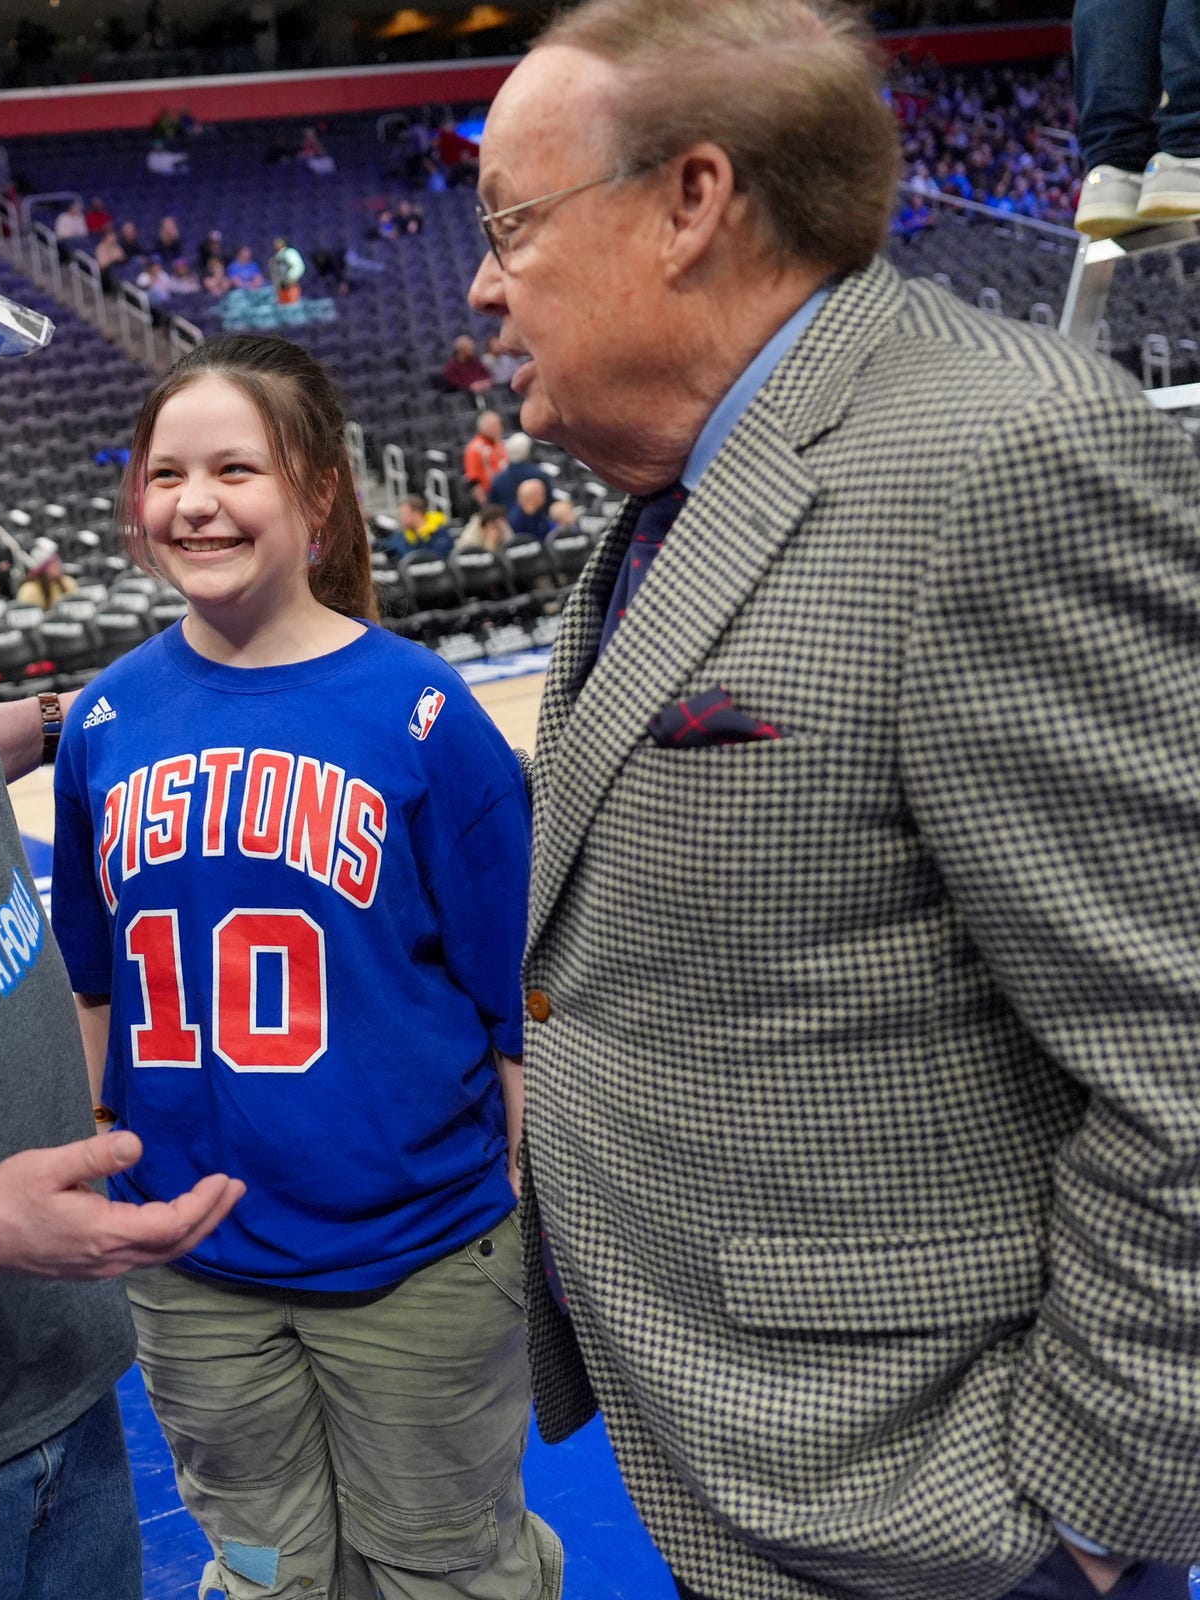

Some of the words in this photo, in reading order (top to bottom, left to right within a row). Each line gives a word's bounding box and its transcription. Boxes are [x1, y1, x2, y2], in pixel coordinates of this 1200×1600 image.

[82, 710, 117, 729] adidas
[99, 747, 387, 916] PISTONS
[125, 907, 328, 1073] 10
